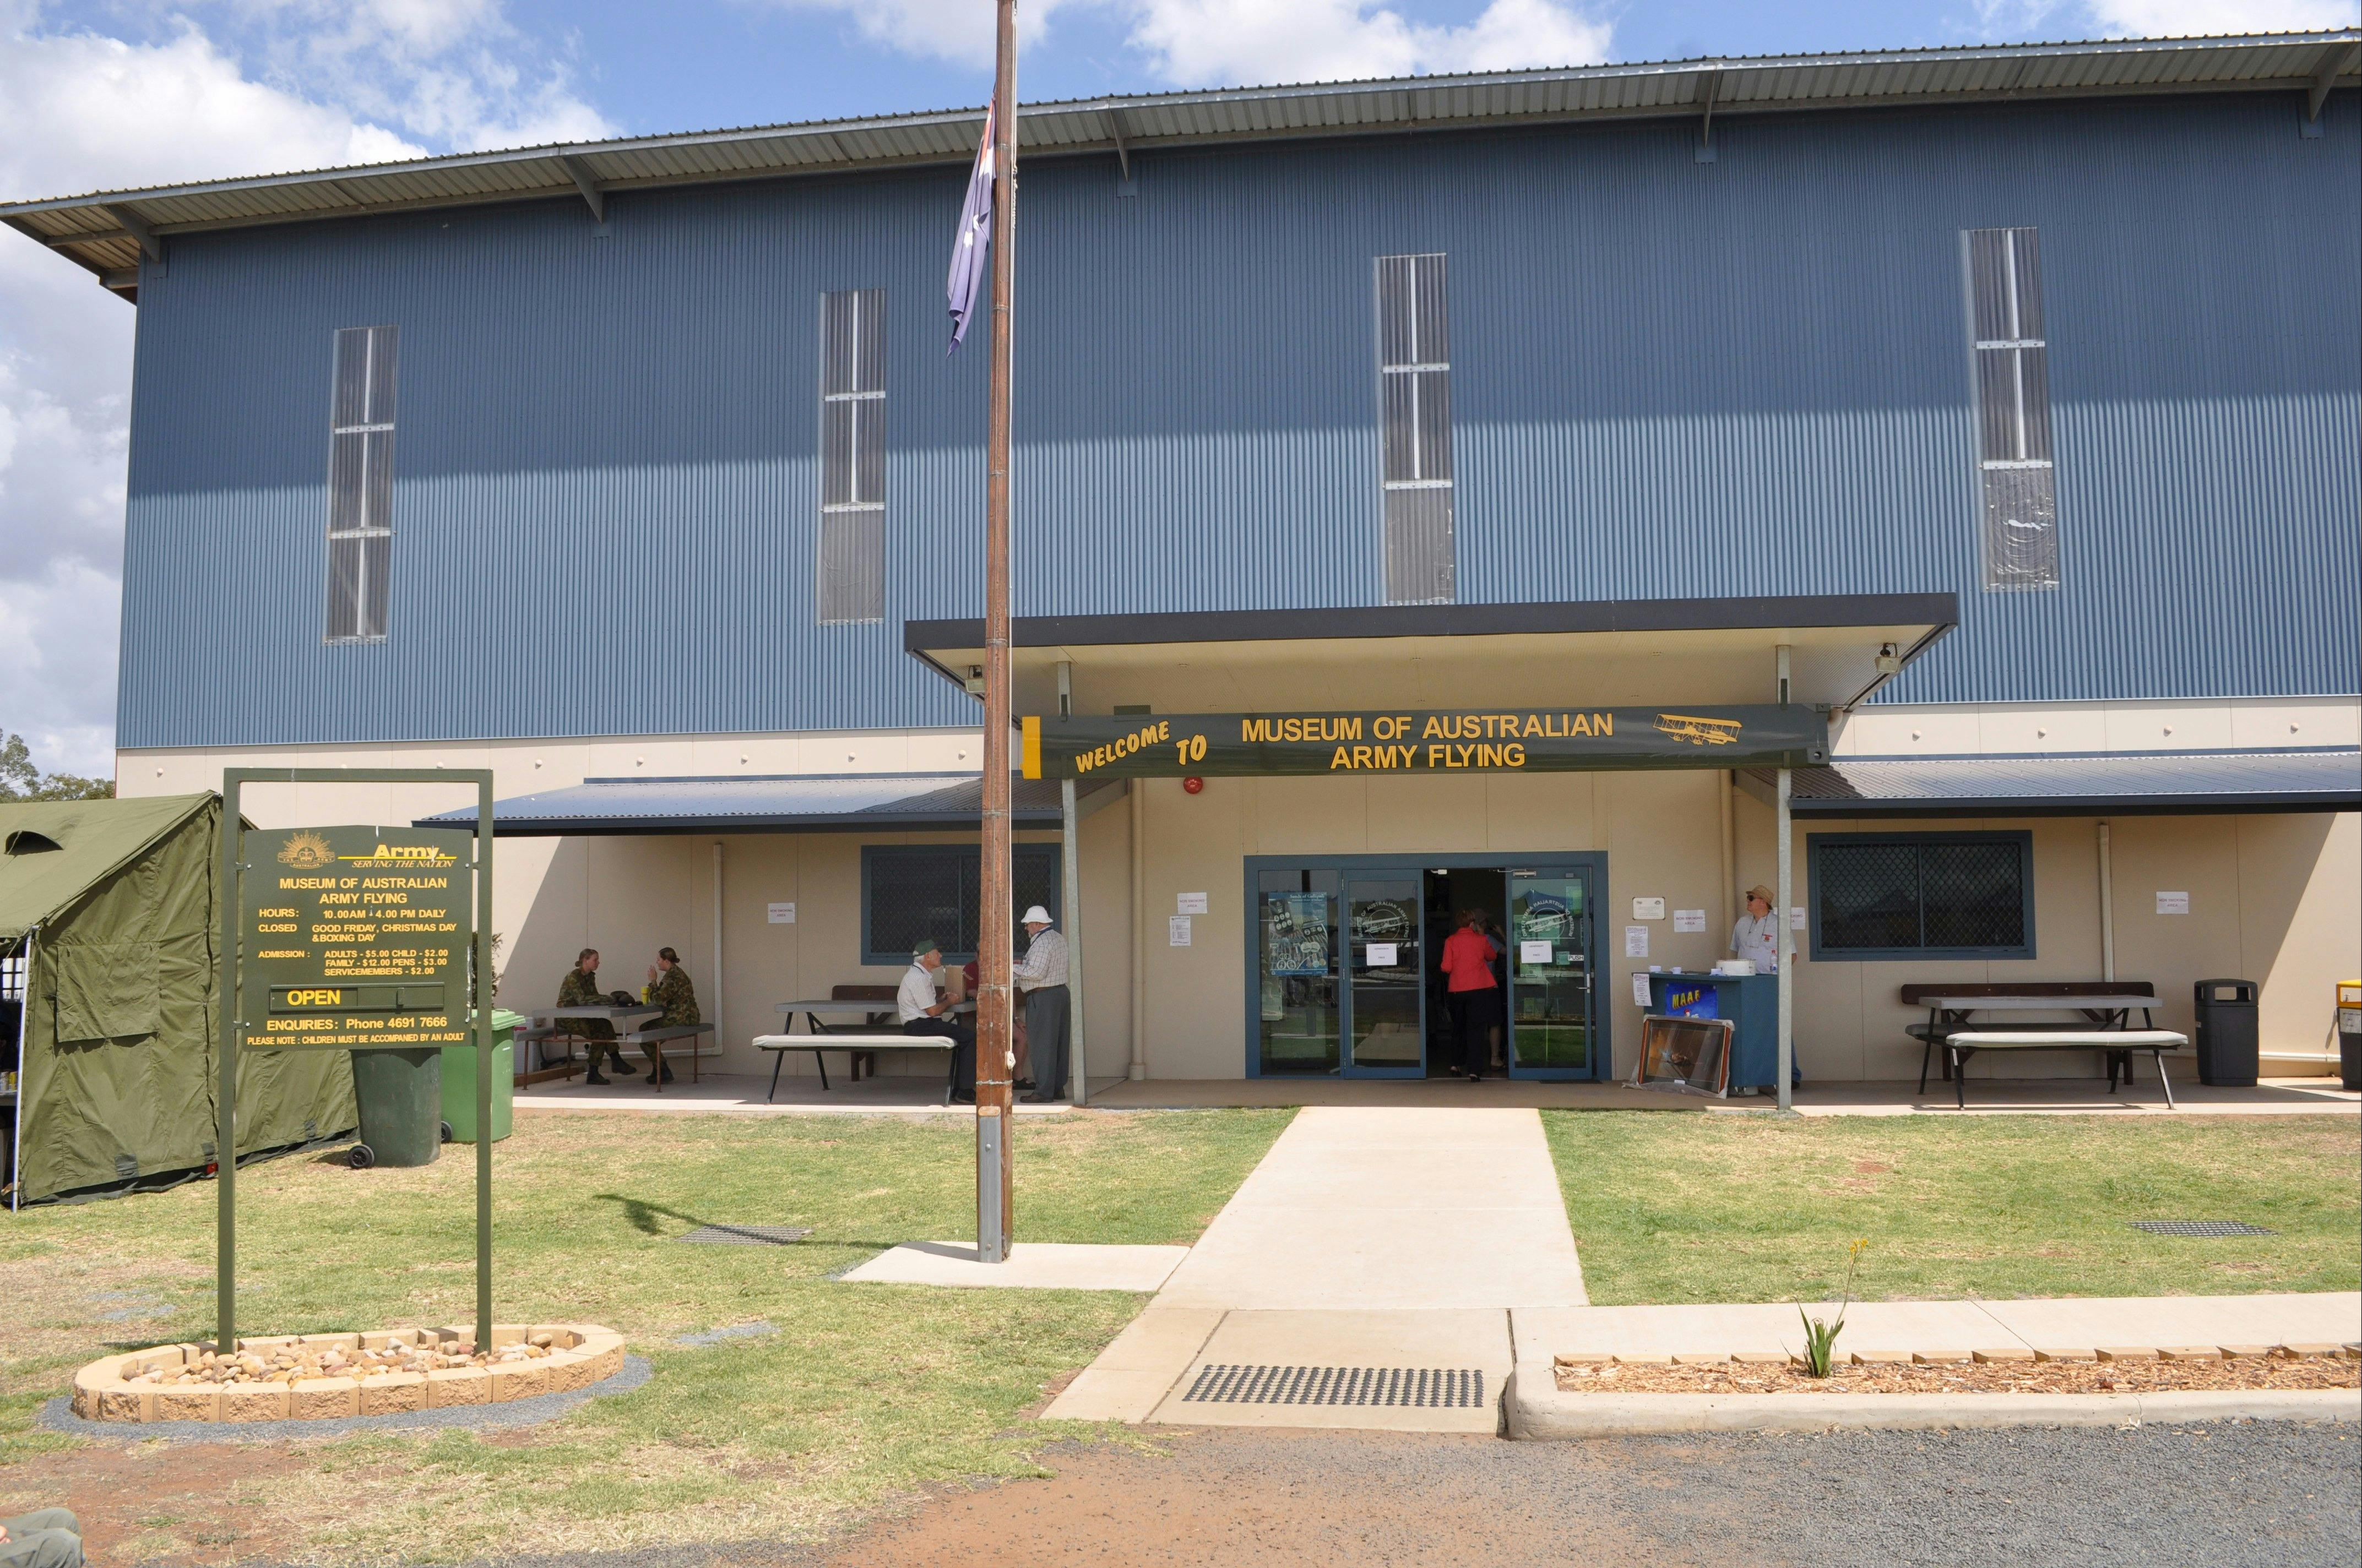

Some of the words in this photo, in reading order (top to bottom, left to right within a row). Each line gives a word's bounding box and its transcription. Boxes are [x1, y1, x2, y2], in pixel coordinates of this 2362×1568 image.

[1242, 717, 1362, 742] MUSEUM
[1373, 716, 1413, 741] OF
[1422, 714, 1614, 739] AUSTRALIAN
[1075, 720, 1170, 774] WELCOME
[1176, 734, 1208, 765] TO
[1330, 745, 1418, 769] ARMY
[1429, 743, 1525, 768] FLYING
[351, 860, 392, 868] SERVING
[393, 860, 415, 868] THE
[416, 860, 454, 868] NATION
[280, 878, 335, 889] MUSEUM
[340, 878, 358, 889] OF
[362, 878, 447, 889] AUSTRALIAN
[319, 893, 360, 904] ARMY
[363, 893, 408, 904] FLYING
[1366, 901, 1398, 911] AUSTRALIAN
[259, 908, 300, 918] HOURS:
[375, 910, 398, 918] 4.00
[400, 910, 416, 918] PM
[419, 909, 447, 918] DAILY
[258, 924, 297, 933] CLOSED
[312, 924, 341, 933] GOOD
[344, 924, 379, 933] FRIDAY,
[382, 924, 437, 932] CHRISTMAS
[438, 923, 457, 932] DAY
[358, 934, 376, 942] DAY
[365, 950, 389, 958] $5.00
[424, 949, 449, 957] $2.00
[362, 959, 390, 967] $12.00
[324, 967, 403, 976] SERVICEMEMBERS
[410, 967, 435, 975] $2.00
[287, 989, 341, 1006] OPEN
[267, 1019, 338, 1031] ENQUIRIES:
[346, 1018, 384, 1029] Phone
[387, 1017, 415, 1028] 4691
[420, 1016, 448, 1027] 7666
[247, 1037, 275, 1045] PLEASE
[302, 1036, 336, 1044] CHILDREN
[338, 1035, 356, 1044] MUST
[359, 1035, 369, 1043] BE
[370, 1033, 419, 1043] ACCOMPANIED
[431, 1033, 442, 1041] AN
[443, 1032, 465, 1041] ADULT
